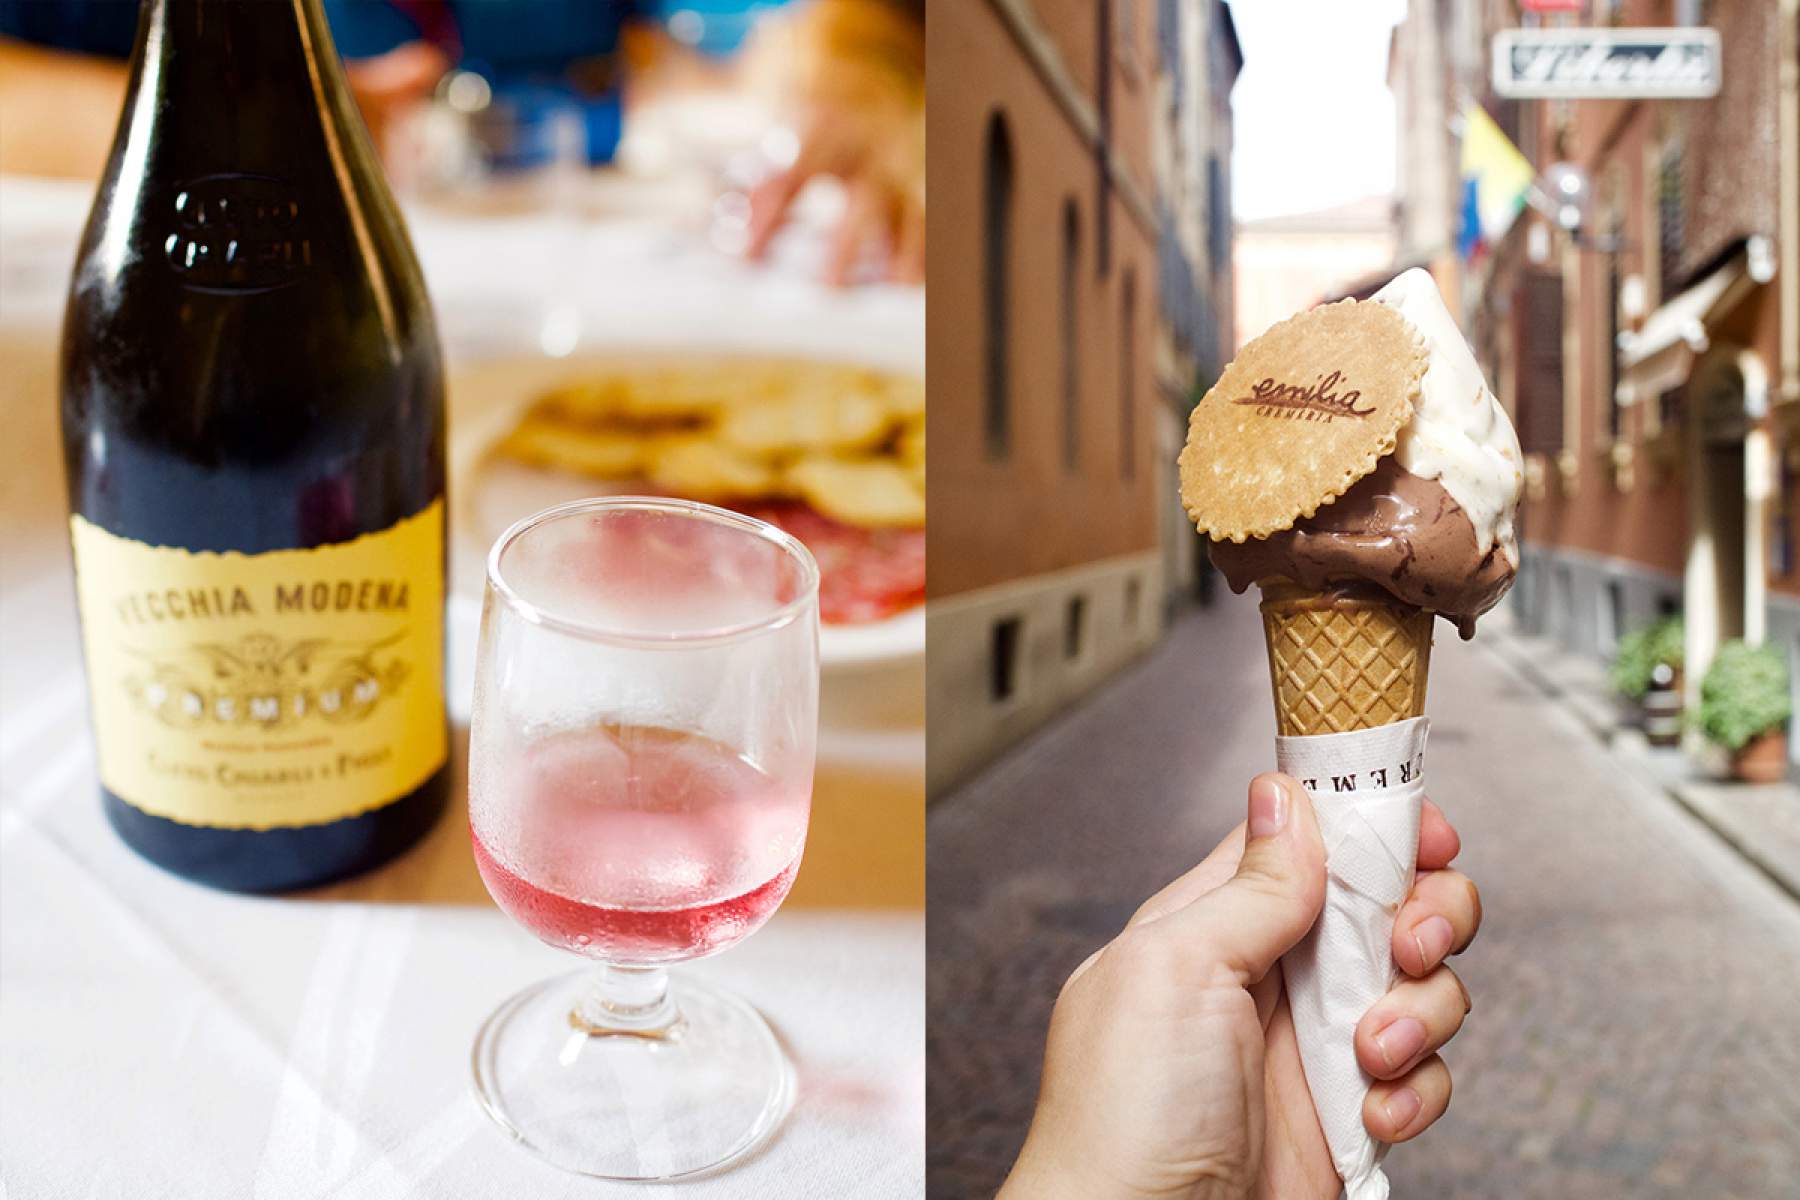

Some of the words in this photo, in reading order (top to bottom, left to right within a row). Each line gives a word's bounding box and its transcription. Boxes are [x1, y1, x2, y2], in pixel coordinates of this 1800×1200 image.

[1252, 370, 1376, 416] emilia
[1256, 406, 1333, 423] CREMERIA
[116, 586, 254, 625] VECCHIA
[276, 578, 410, 613] MODENA
[144, 677, 381, 722] PREMIUM
